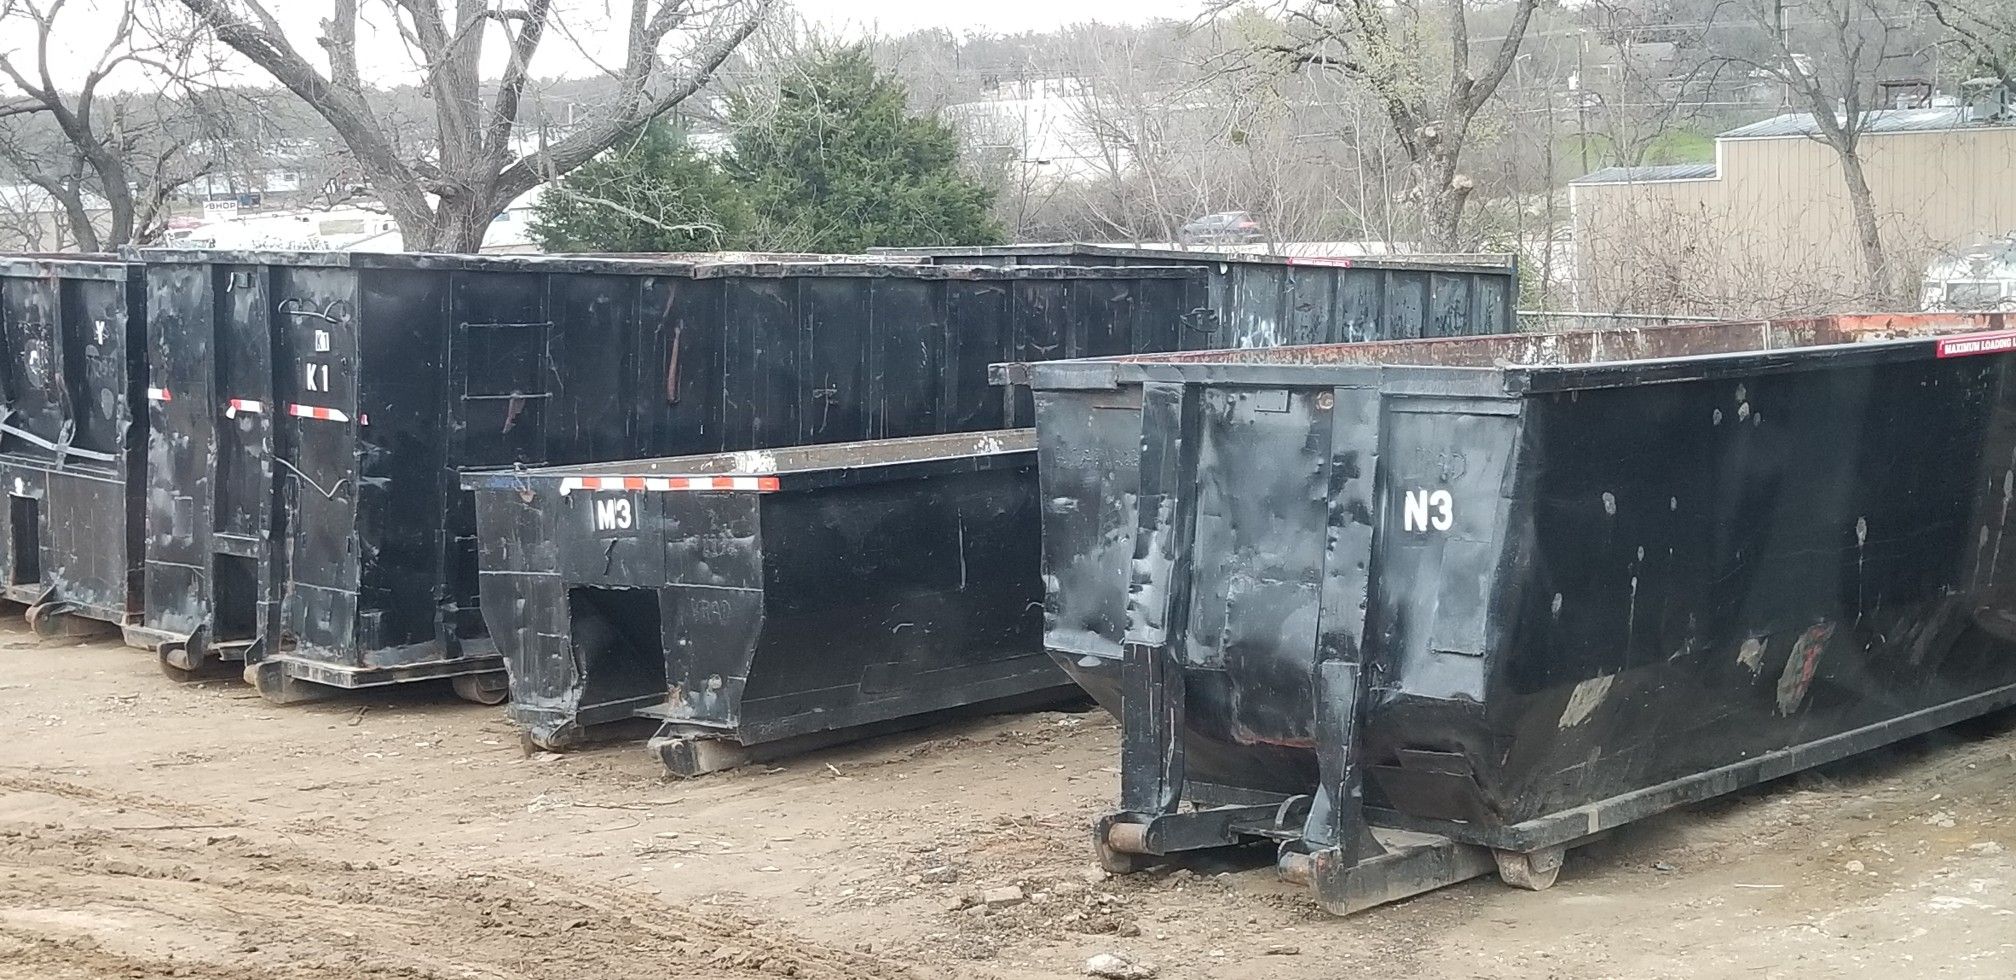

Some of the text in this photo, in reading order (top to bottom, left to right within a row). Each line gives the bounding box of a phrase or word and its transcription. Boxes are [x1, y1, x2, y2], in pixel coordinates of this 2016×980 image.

[1945, 341, 1980, 355] MAXIMUM
[1981, 337, 2012, 351] LOADING
[597, 499, 632, 530] M3
[1404, 489, 1453, 531] N3
